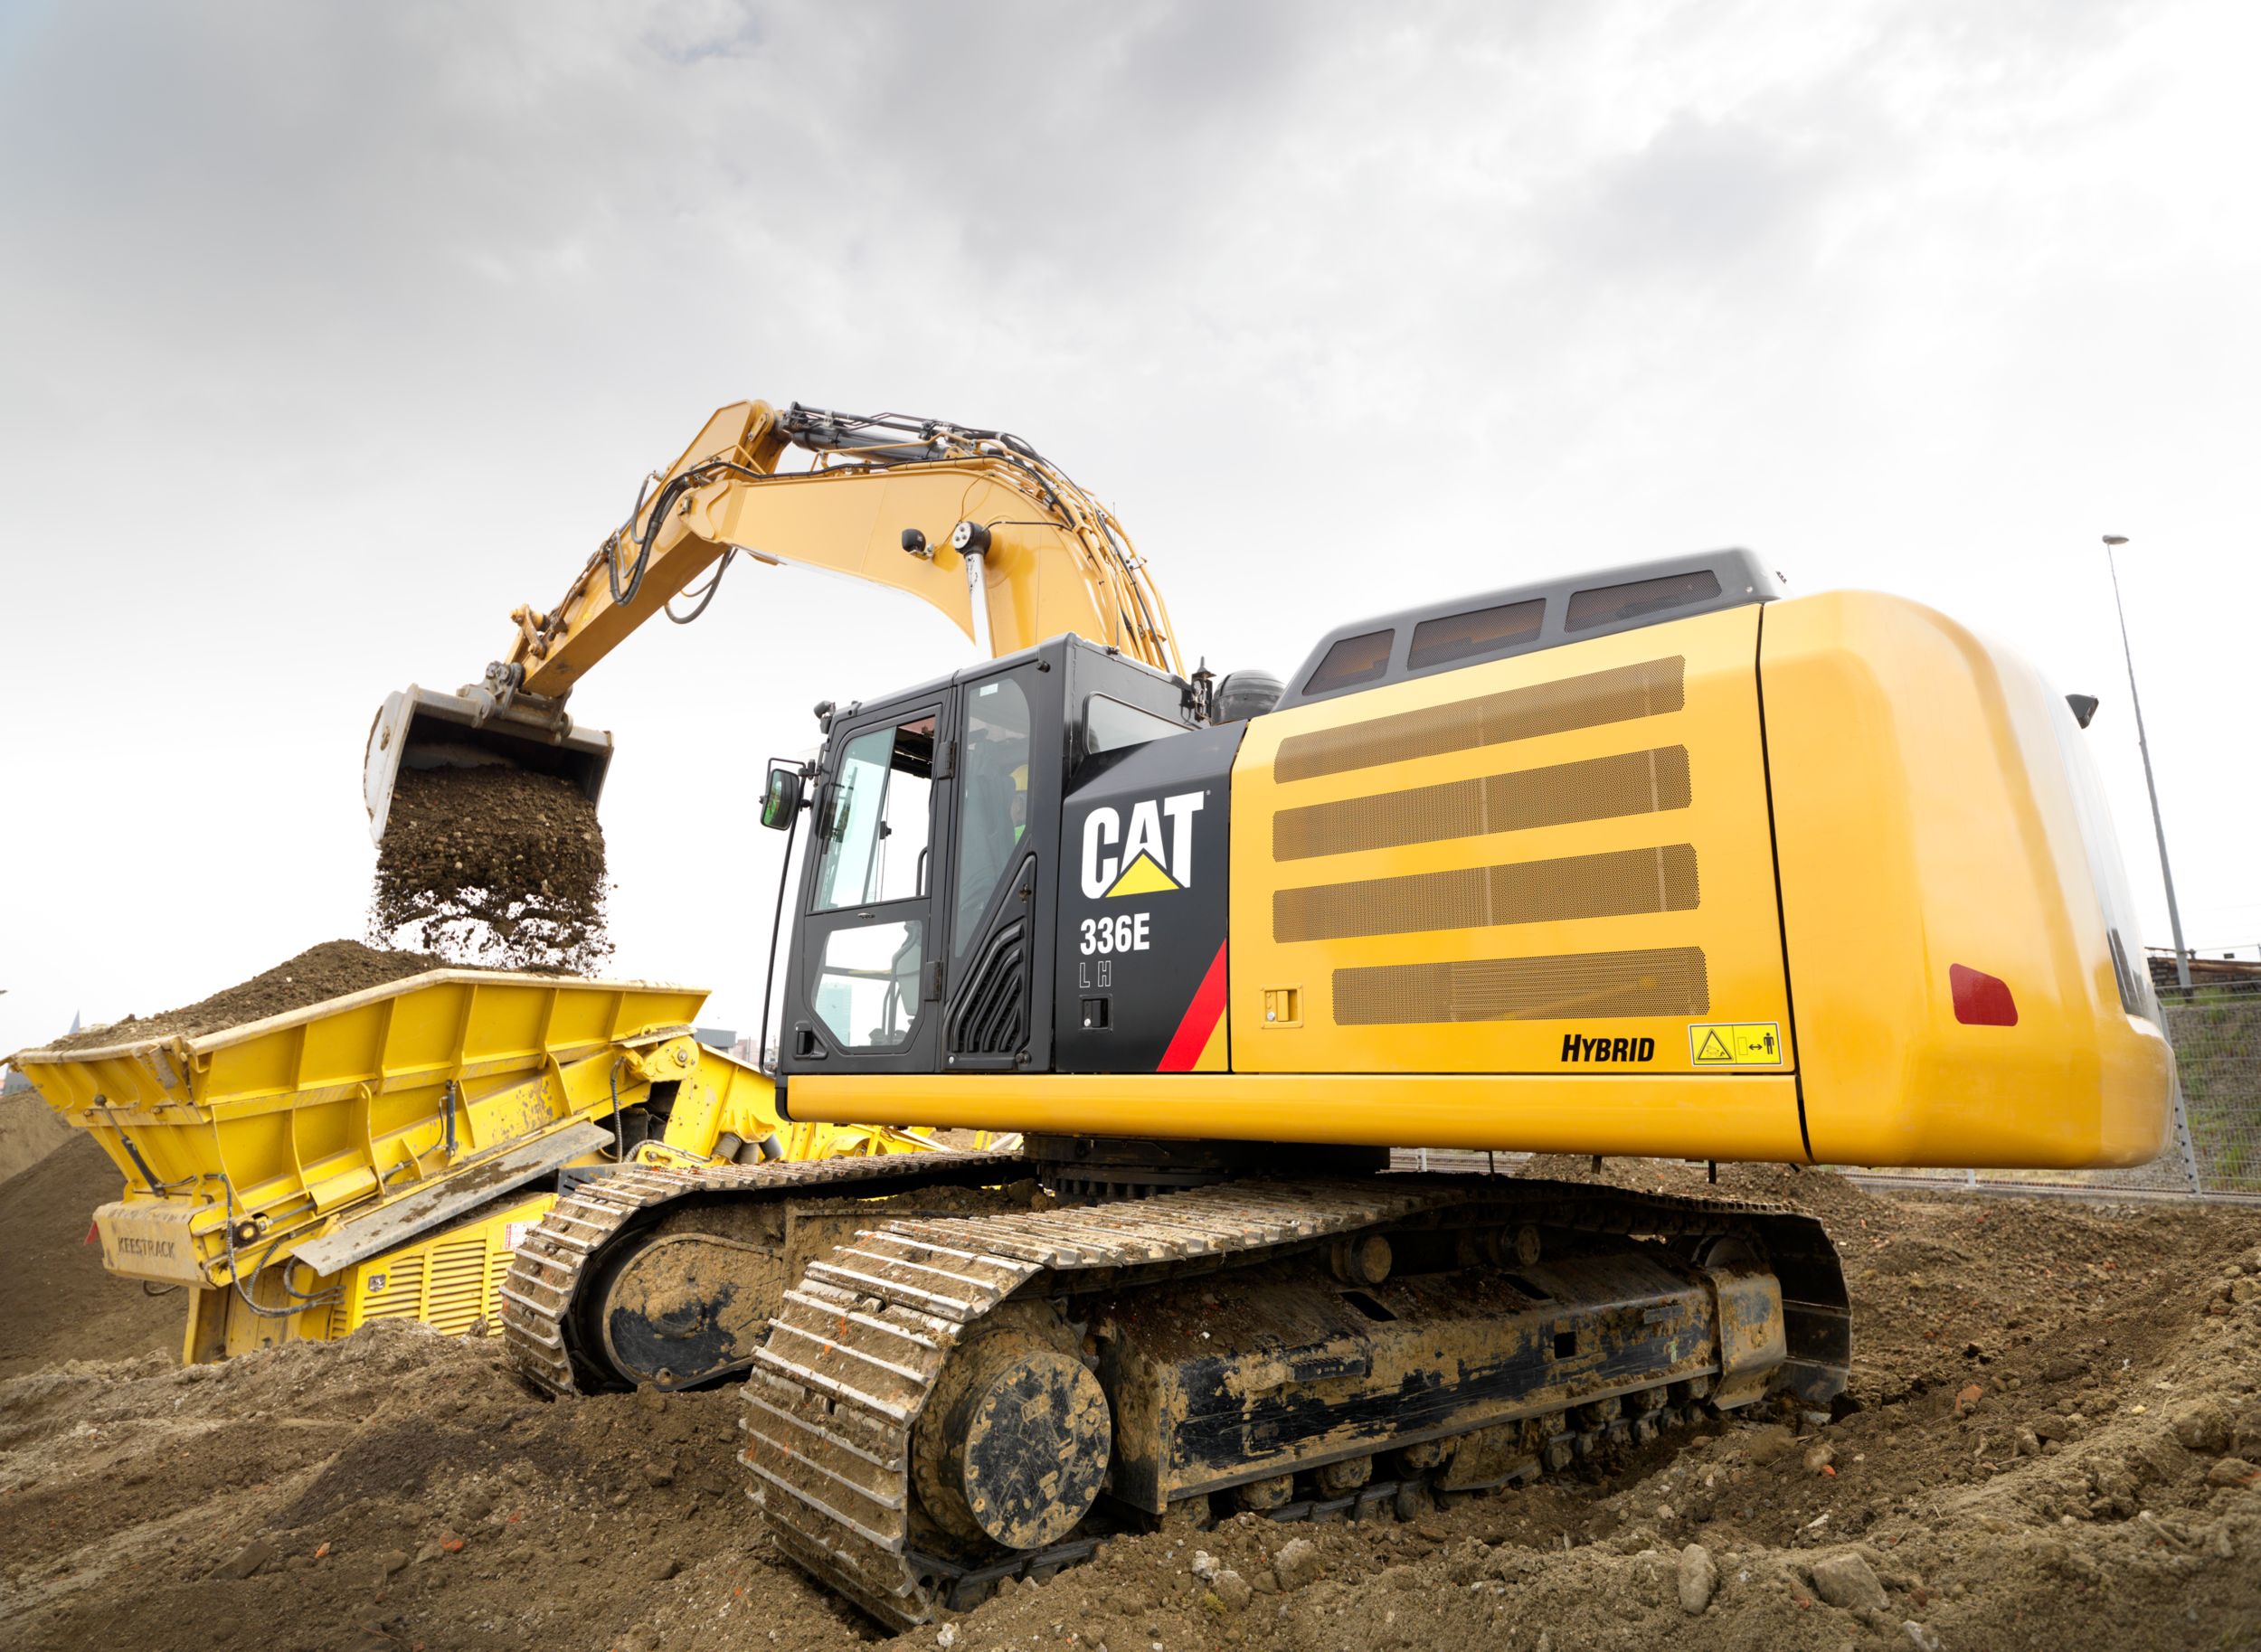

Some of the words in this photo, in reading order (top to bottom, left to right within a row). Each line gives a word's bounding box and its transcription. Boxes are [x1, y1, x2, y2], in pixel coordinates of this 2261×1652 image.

[1081, 790, 1205, 900] CAT
[1080, 912, 1150, 956] 336E
[1561, 1034, 1655, 1062] HYBRID
[118, 1236, 175, 1258] KEESTRACK
